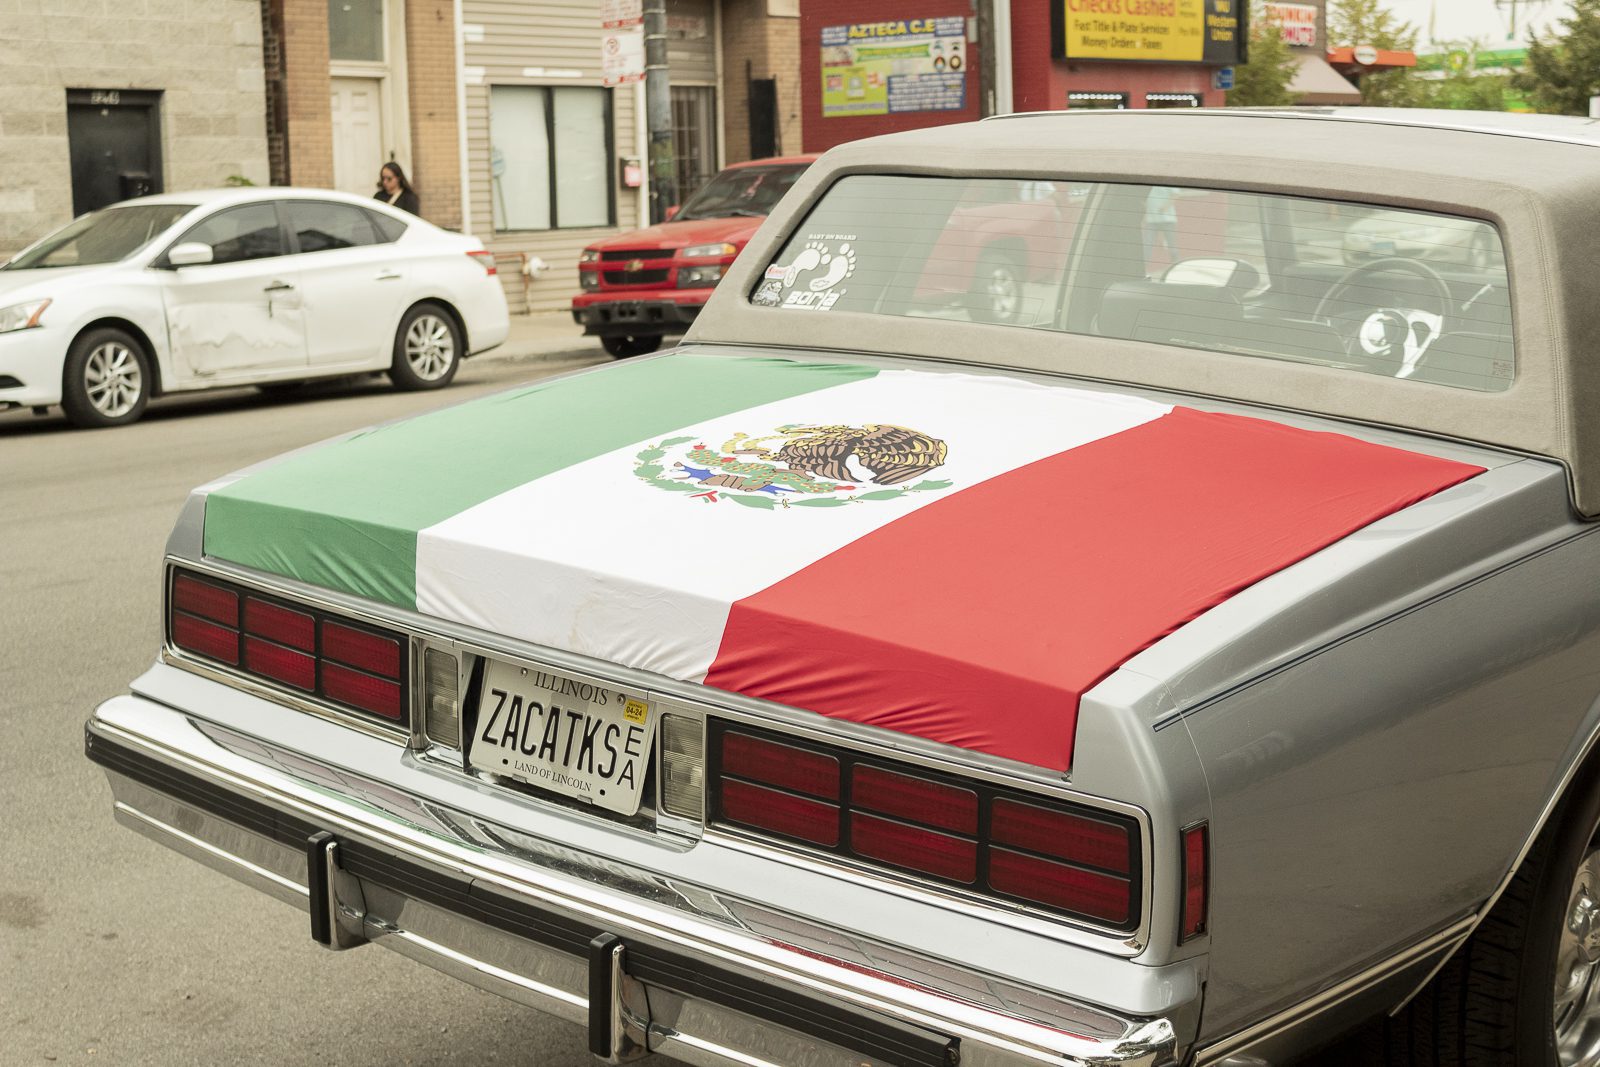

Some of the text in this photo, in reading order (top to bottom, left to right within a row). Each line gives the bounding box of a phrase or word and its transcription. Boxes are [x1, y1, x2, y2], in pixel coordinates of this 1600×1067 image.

[1126, 0, 1176, 17] Cashed
[848, 20, 907, 38] AZTECA
[1081, 35, 1108, 49] Money
[533, 671, 610, 706] ILLINOIS
[626, 706, 643, 717] 04-24
[481, 687, 621, 779] ZACATKS
[514, 760, 592, 792] LAND OF LINCOLN
